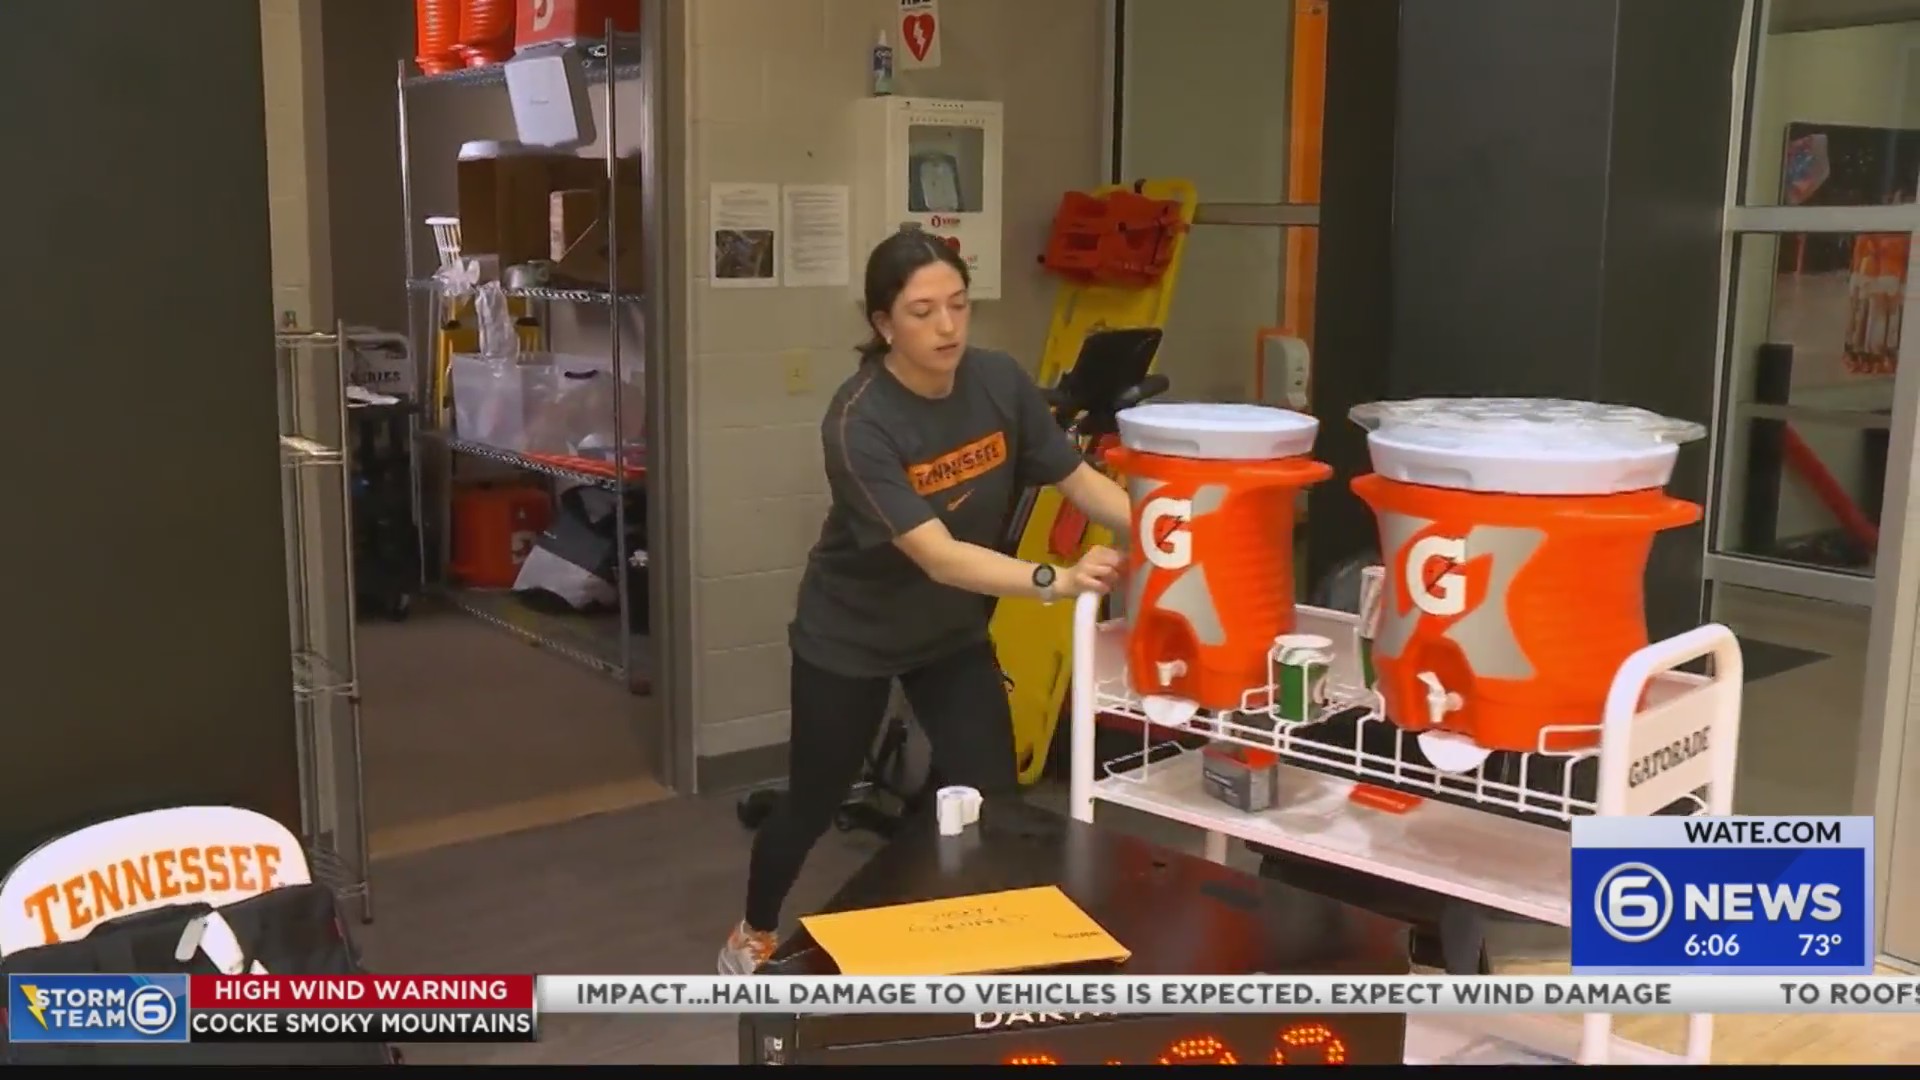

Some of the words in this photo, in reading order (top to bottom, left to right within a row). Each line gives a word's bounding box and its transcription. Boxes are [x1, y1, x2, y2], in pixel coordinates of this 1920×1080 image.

[1140, 496, 1193, 570] G
[1405, 534, 1467, 616] G
[1628, 725, 1711, 789] GATORADE
